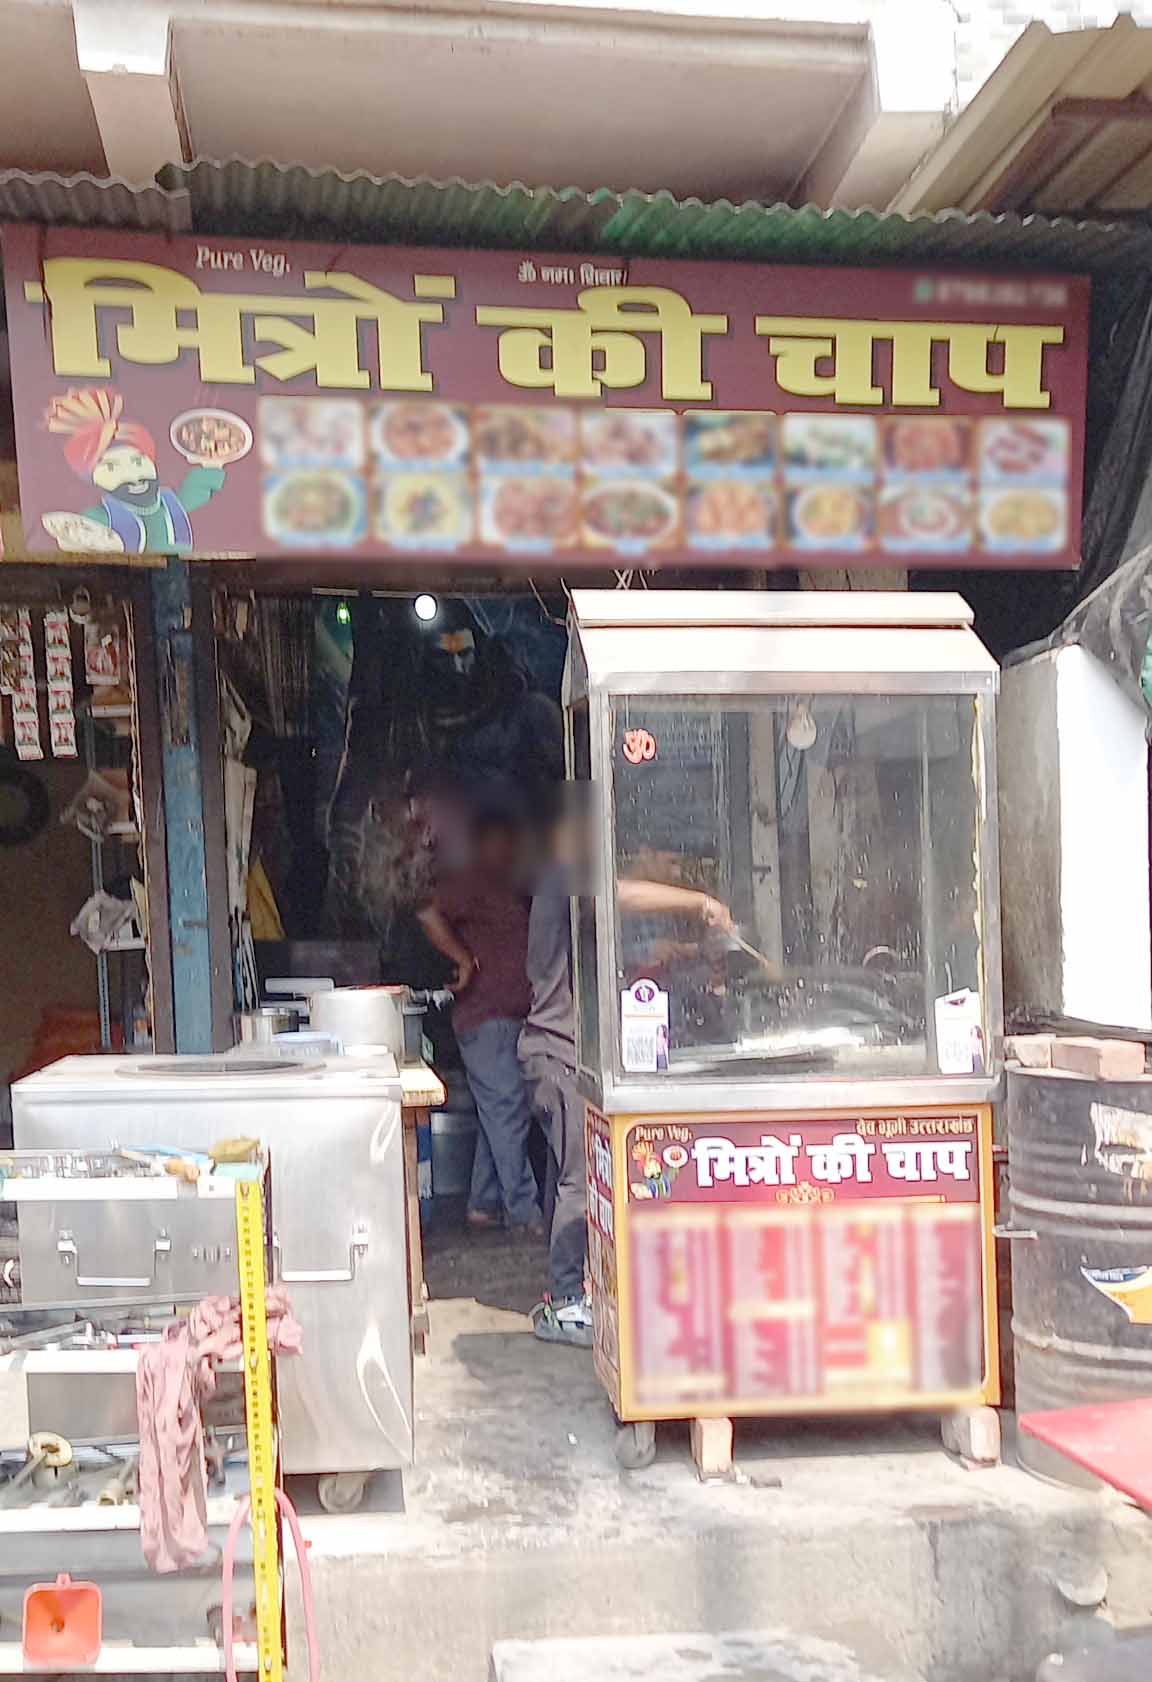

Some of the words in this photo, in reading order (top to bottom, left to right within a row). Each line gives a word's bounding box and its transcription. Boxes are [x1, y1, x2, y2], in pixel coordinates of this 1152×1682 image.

[196, 245, 243, 272] Pure
[249, 248, 290, 278] Veg.
[24, 257, 456, 392] मित्रों
[476, 285, 728, 401] की
[755, 315, 1064, 409] चाप
[634, 1125, 664, 1141] Pure
[691, 1134, 802, 1188] मित्रों
[805, 1134, 876, 1183] की
[881, 1140, 972, 1182] चाप
